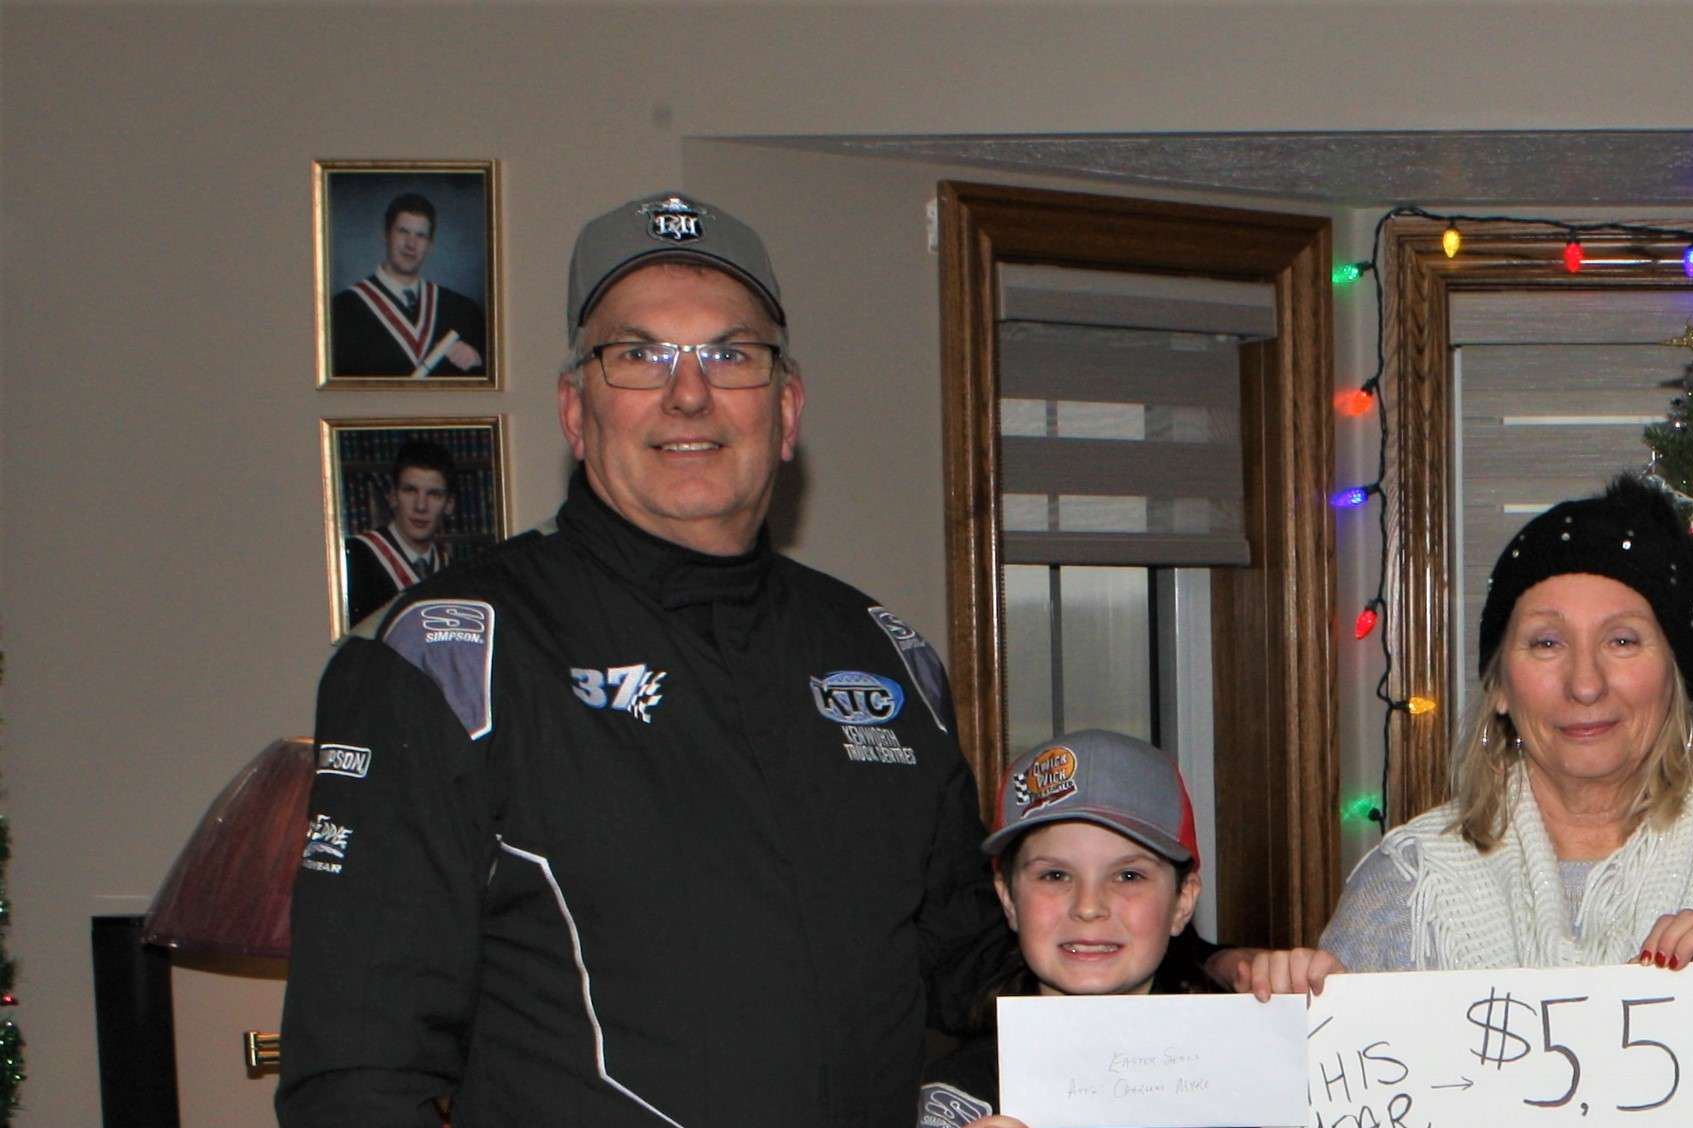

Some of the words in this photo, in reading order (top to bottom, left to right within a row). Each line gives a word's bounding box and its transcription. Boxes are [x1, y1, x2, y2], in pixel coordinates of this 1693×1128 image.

[425, 631, 484, 644] SIMPSON
[570, 664, 645, 709] 37
[812, 680, 895, 719] KTC
[320, 750, 367, 774] PSON
